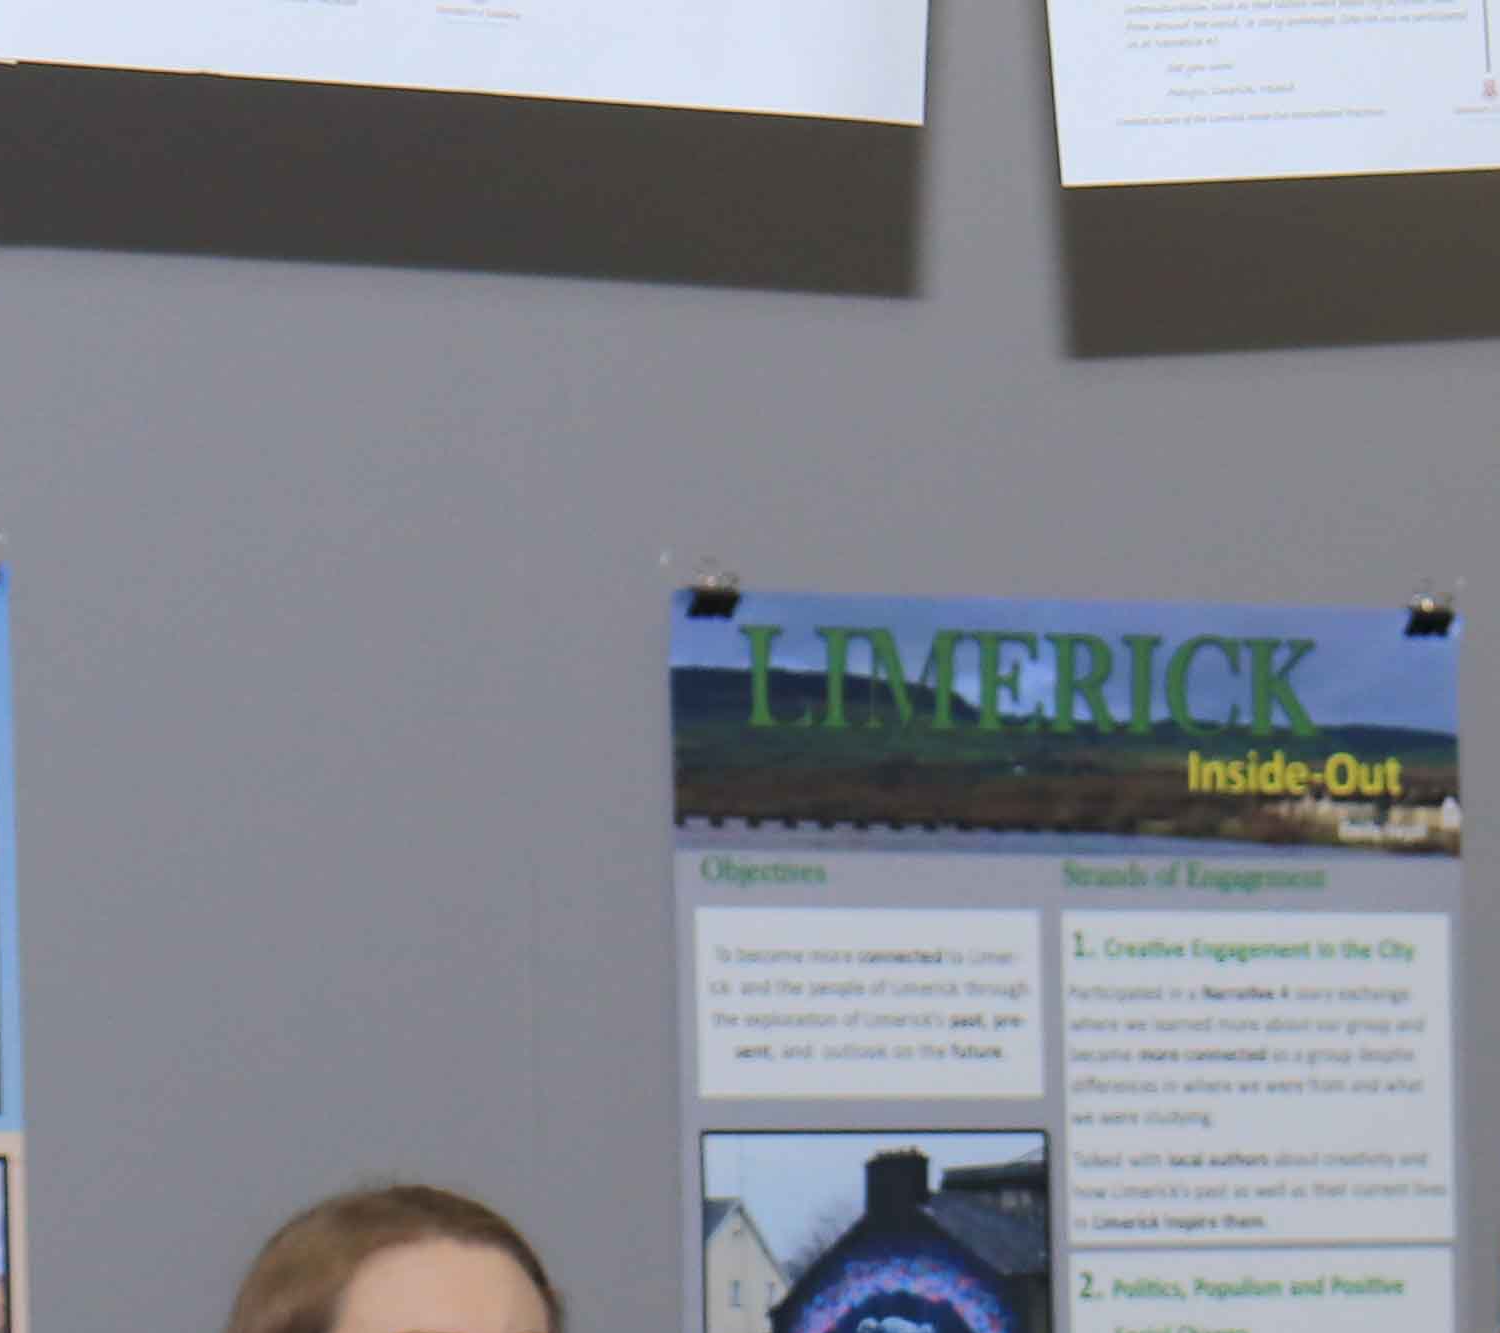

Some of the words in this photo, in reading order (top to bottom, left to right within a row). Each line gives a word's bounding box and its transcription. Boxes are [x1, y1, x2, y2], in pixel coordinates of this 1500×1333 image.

[738, 624, 1319, 738] LIMERICK
[1187, 749, 1401, 796] Inside-Out
[701, 856, 827, 889] Objectives
[1063, 860, 1147, 888] Strands
[1155, 861, 1180, 887] of
[1186, 861, 1327, 893] Engagement
[1073, 929, 1095, 959] 1.
[1104, 937, 1184, 960] Creative
[1192, 939, 1311, 963] Engagement
[1342, 939, 1372, 960] the
[1378, 939, 1415, 962] City
[1079, 1275, 1105, 1299] 2.
[1112, 1278, 1188, 1300] Politics,
[1194, 1278, 1282, 1299] Populism
[1290, 1277, 1325, 1296] and
[1331, 1275, 1404, 1295] Positive
